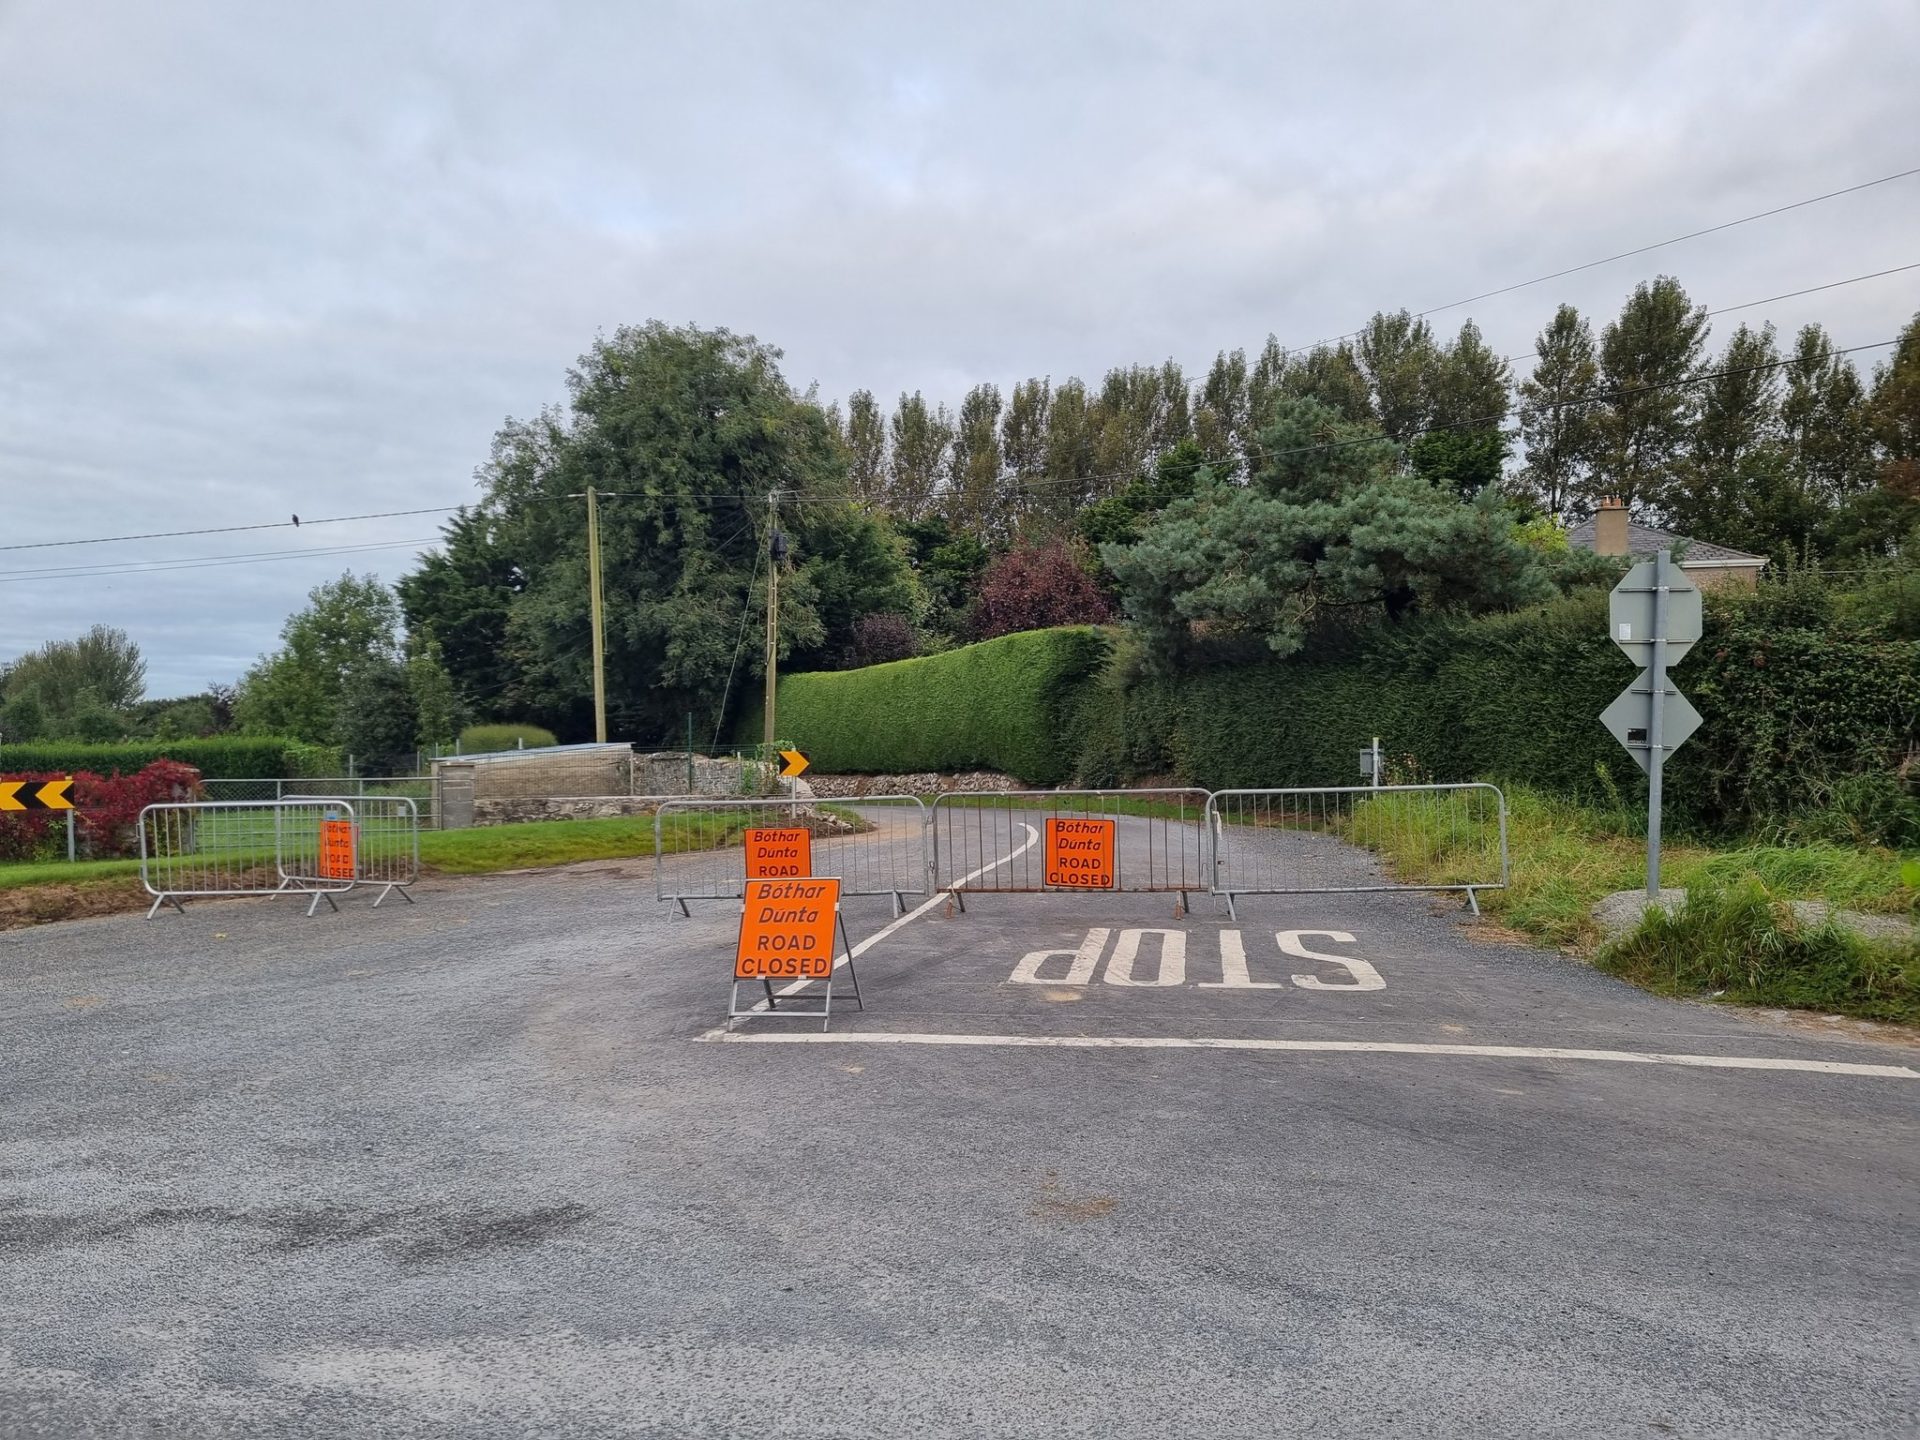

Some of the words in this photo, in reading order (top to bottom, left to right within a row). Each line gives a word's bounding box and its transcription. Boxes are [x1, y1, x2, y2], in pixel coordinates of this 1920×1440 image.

[1057, 821, 1104, 834] Bóthar
[753, 831, 800, 842] Bóthar
[1058, 838, 1101, 850] Dúnta
[757, 847, 798, 858] Dúnta
[1060, 857, 1101, 869] ROAD
[759, 866, 799, 876] ROAD
[1049, 872, 1110, 885] CLOSED
[757, 882, 826, 899] Bóthar
[759, 906, 819, 923] Dúnta
[757, 935, 816, 951] ROAD
[741, 958, 827, 974] CLOSED
[1007, 928, 1387, 991] STOP
